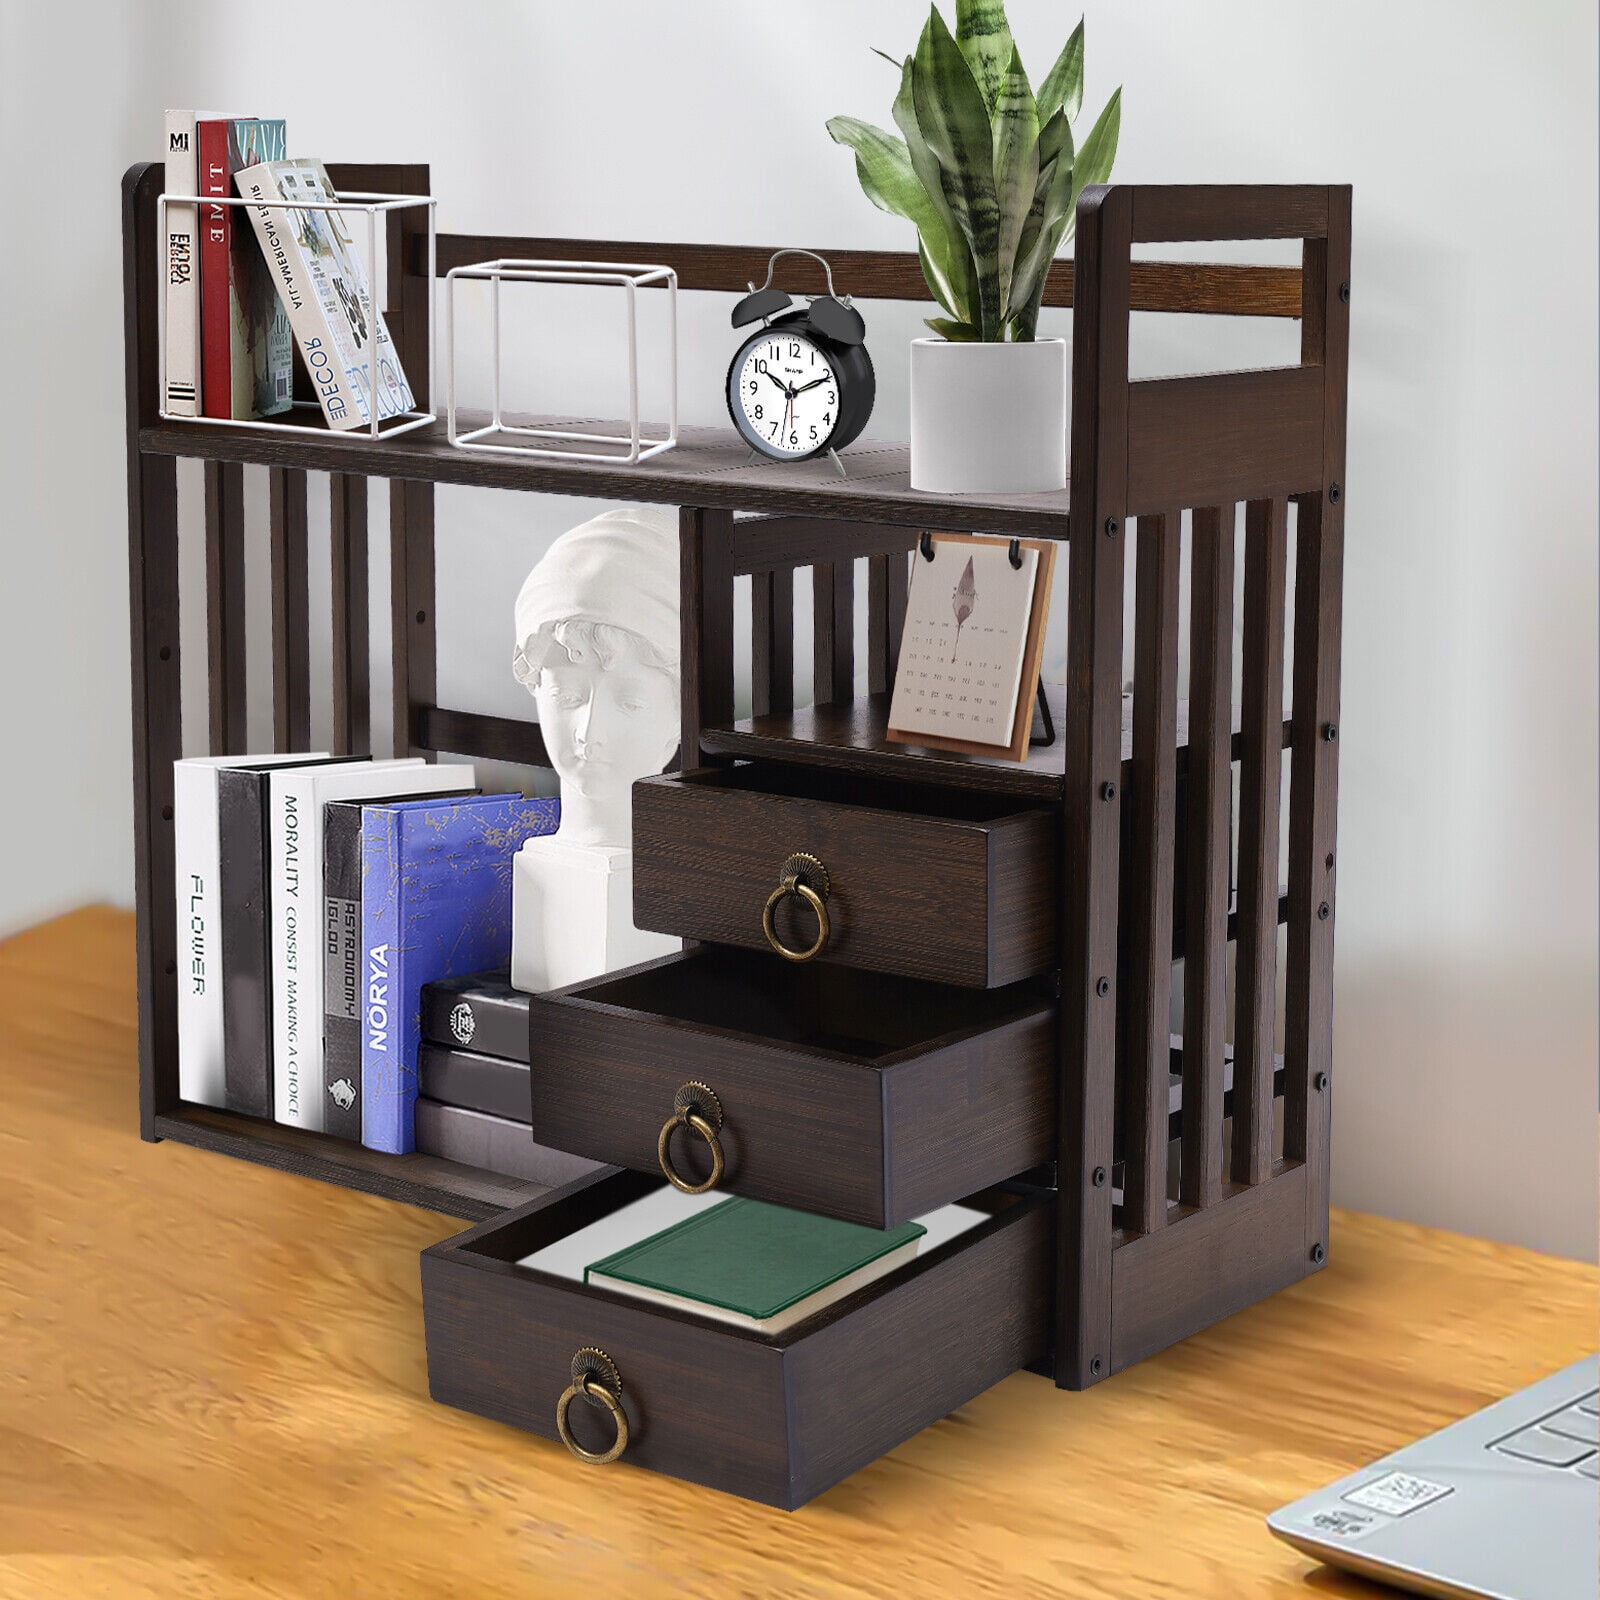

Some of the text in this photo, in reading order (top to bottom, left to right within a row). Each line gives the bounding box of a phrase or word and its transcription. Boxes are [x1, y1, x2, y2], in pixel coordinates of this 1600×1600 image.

[769, 345, 780, 361] 11
[789, 342, 801, 358] 12
[754, 358, 768, 374] 10
[822, 368, 832, 383] 2
[749, 381, 758, 396] 9
[827, 391, 836, 405] 3
[754, 404, 764, 420] 8
[822, 412, 831, 426] 4
[769, 421, 779, 437] 7
[809, 425, 818, 440] 5
[789, 430, 799, 445] 6
[190, 874, 206, 996] FLOWER
[327, 900, 339, 955] IGLOO
[285, 795, 300, 1117] MORALITY CONSIST MAKING A CHOICE
[344, 903, 356, 1018] ASTRONOMY
